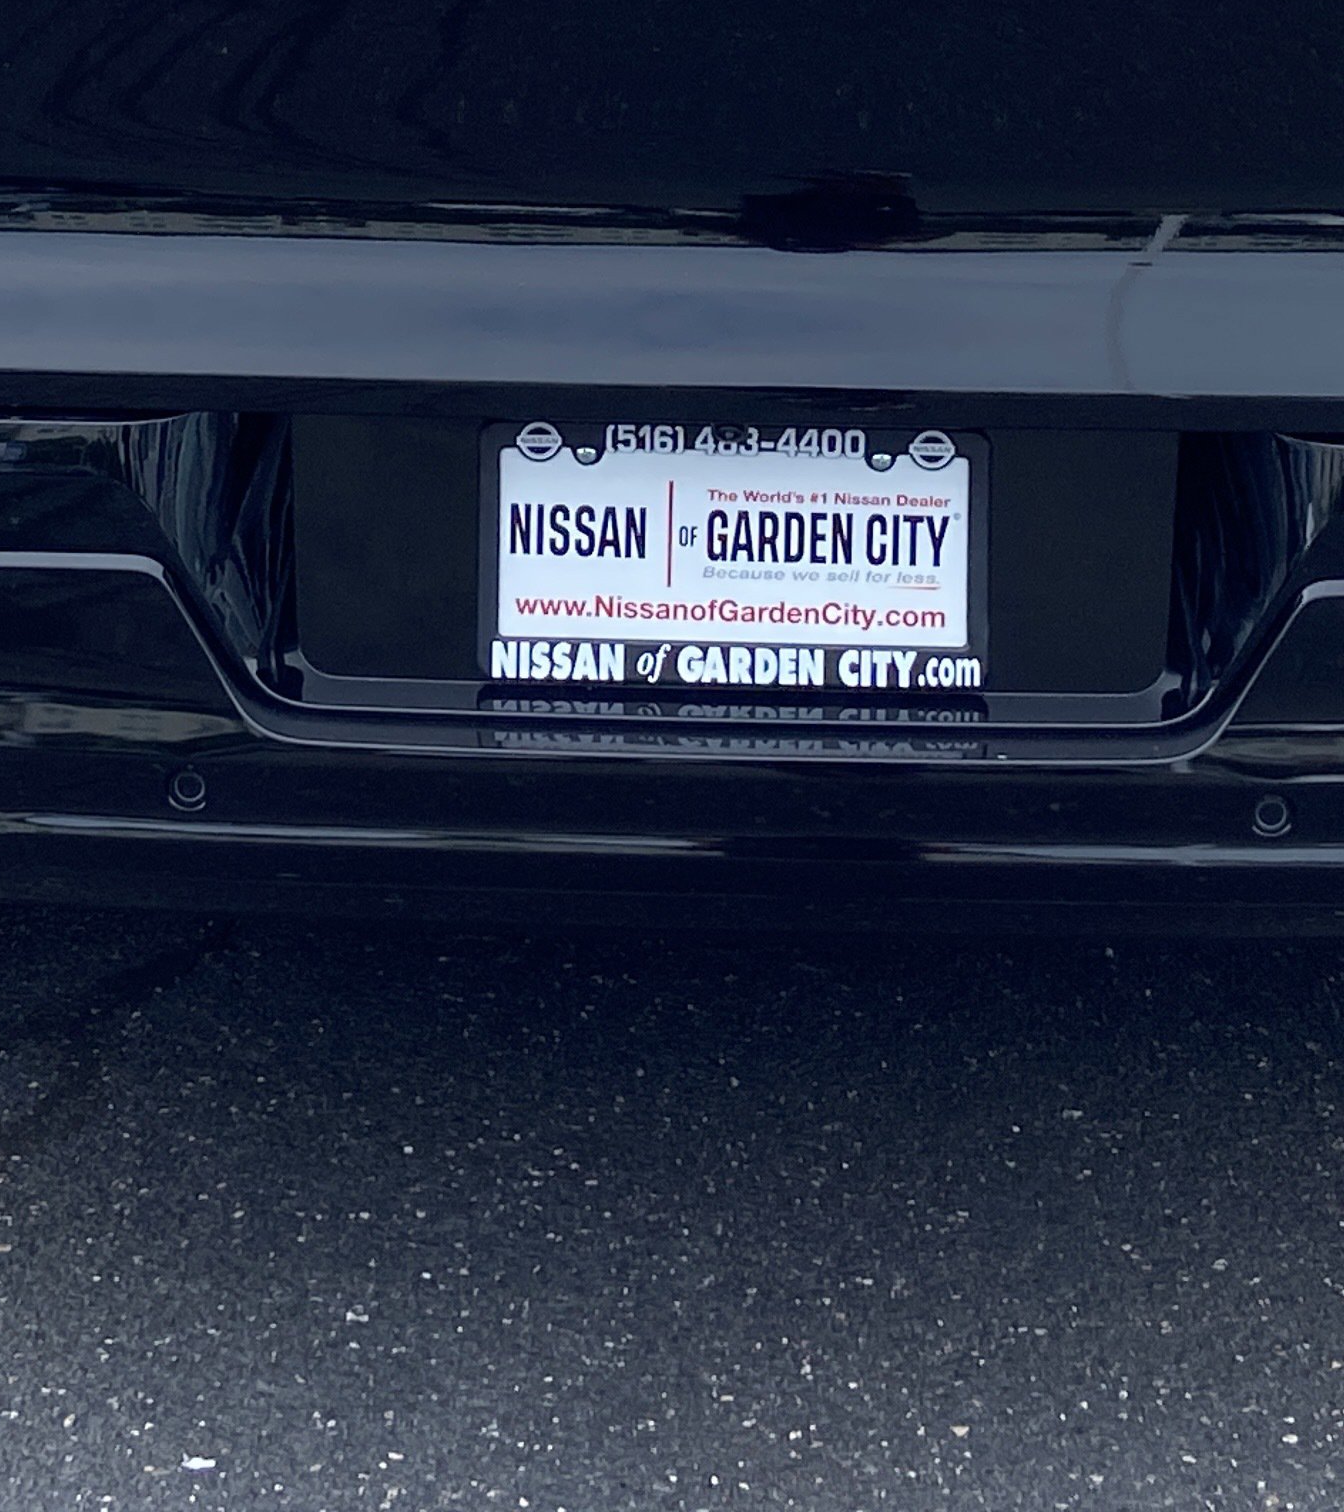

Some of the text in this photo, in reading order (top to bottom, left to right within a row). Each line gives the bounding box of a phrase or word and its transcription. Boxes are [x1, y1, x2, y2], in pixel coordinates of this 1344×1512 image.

[606, 424, 685, 454] (516)
[707, 489, 952, 508] The World's #1 Nissan Dealer
[509, 502, 950, 567] NISSAN OF GARDEN CITY
[702, 566, 941, 586] Because we sell for less.
[515, 594, 946, 631] www.NissanofGardenCity.com
[490, 640, 982, 688] NISSAN of GARDEN CITY.com
